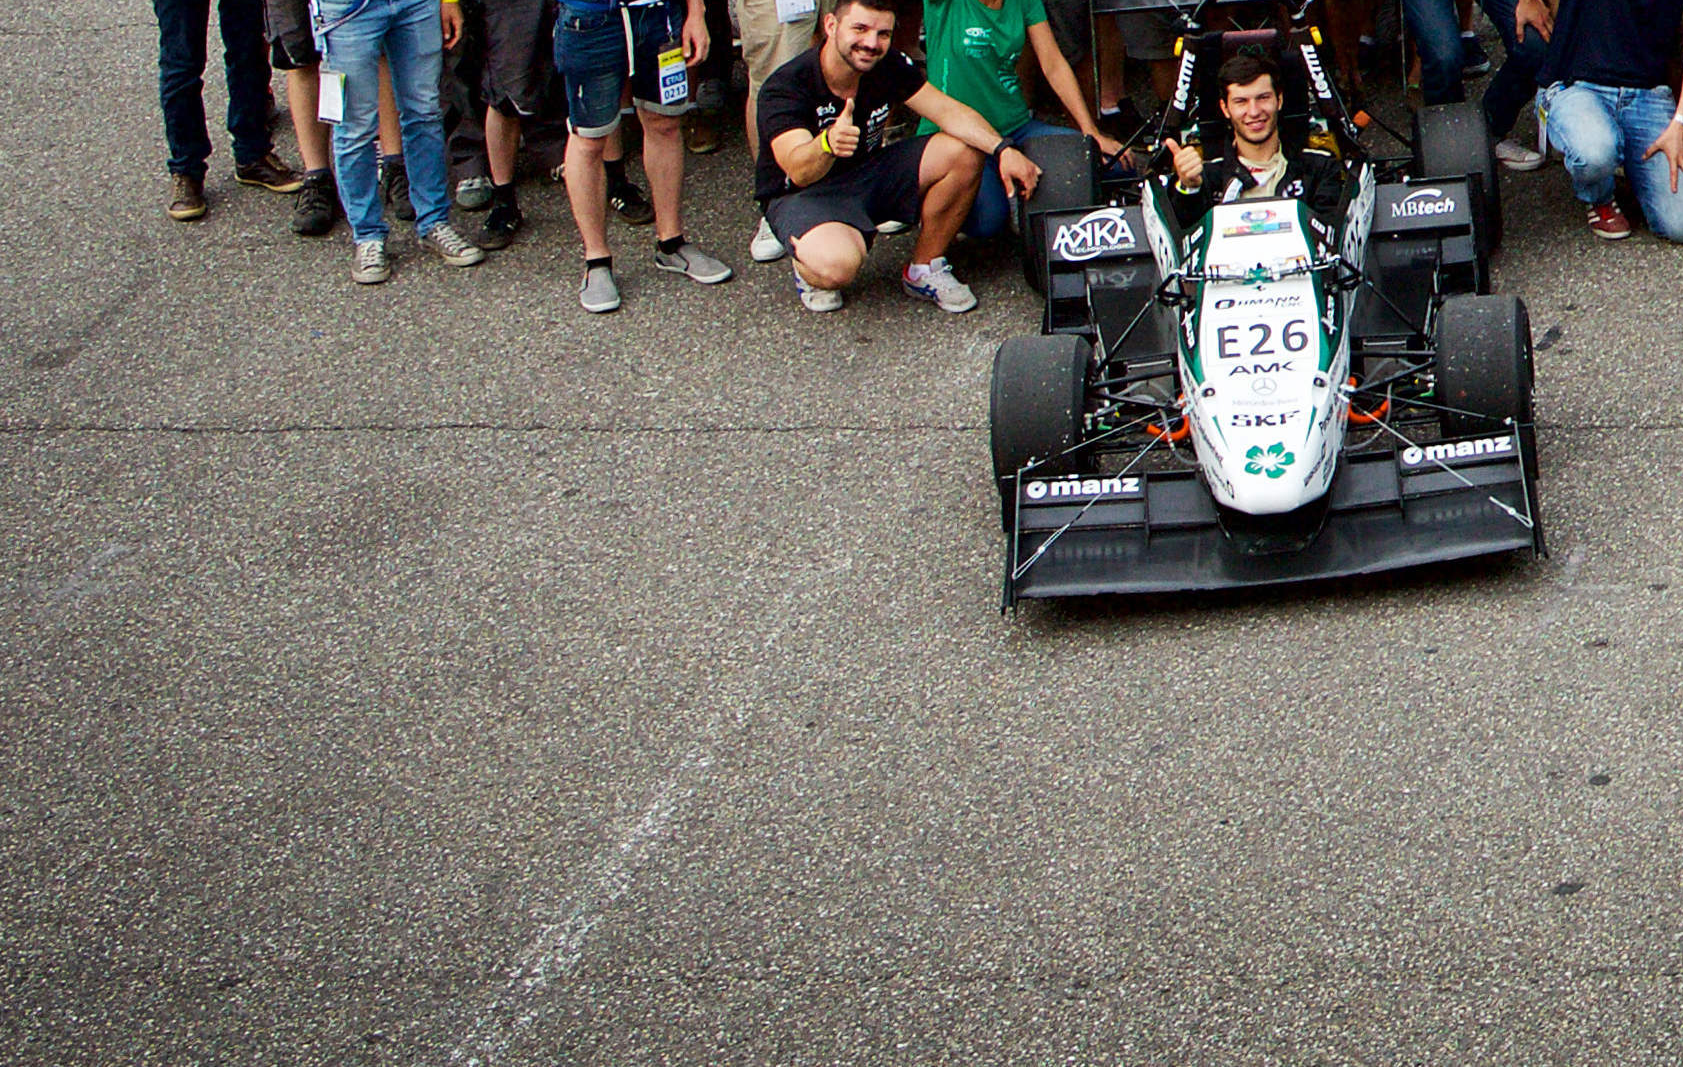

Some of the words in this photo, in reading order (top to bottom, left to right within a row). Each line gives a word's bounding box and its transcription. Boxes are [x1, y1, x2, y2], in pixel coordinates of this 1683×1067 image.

[1173, 49, 1197, 112] LOCTITE
[1300, 44, 1332, 100] LOCTITE
[664, 84, 687, 100] 0213
[1391, 197, 1456, 219] MBtech
[1217, 319, 1309, 360] E26
[1228, 360, 1296, 377] AMK
[1230, 410, 1301, 428] SKF
[1425, 436, 1513, 462] manz
[1050, 477, 1140, 497] manz
